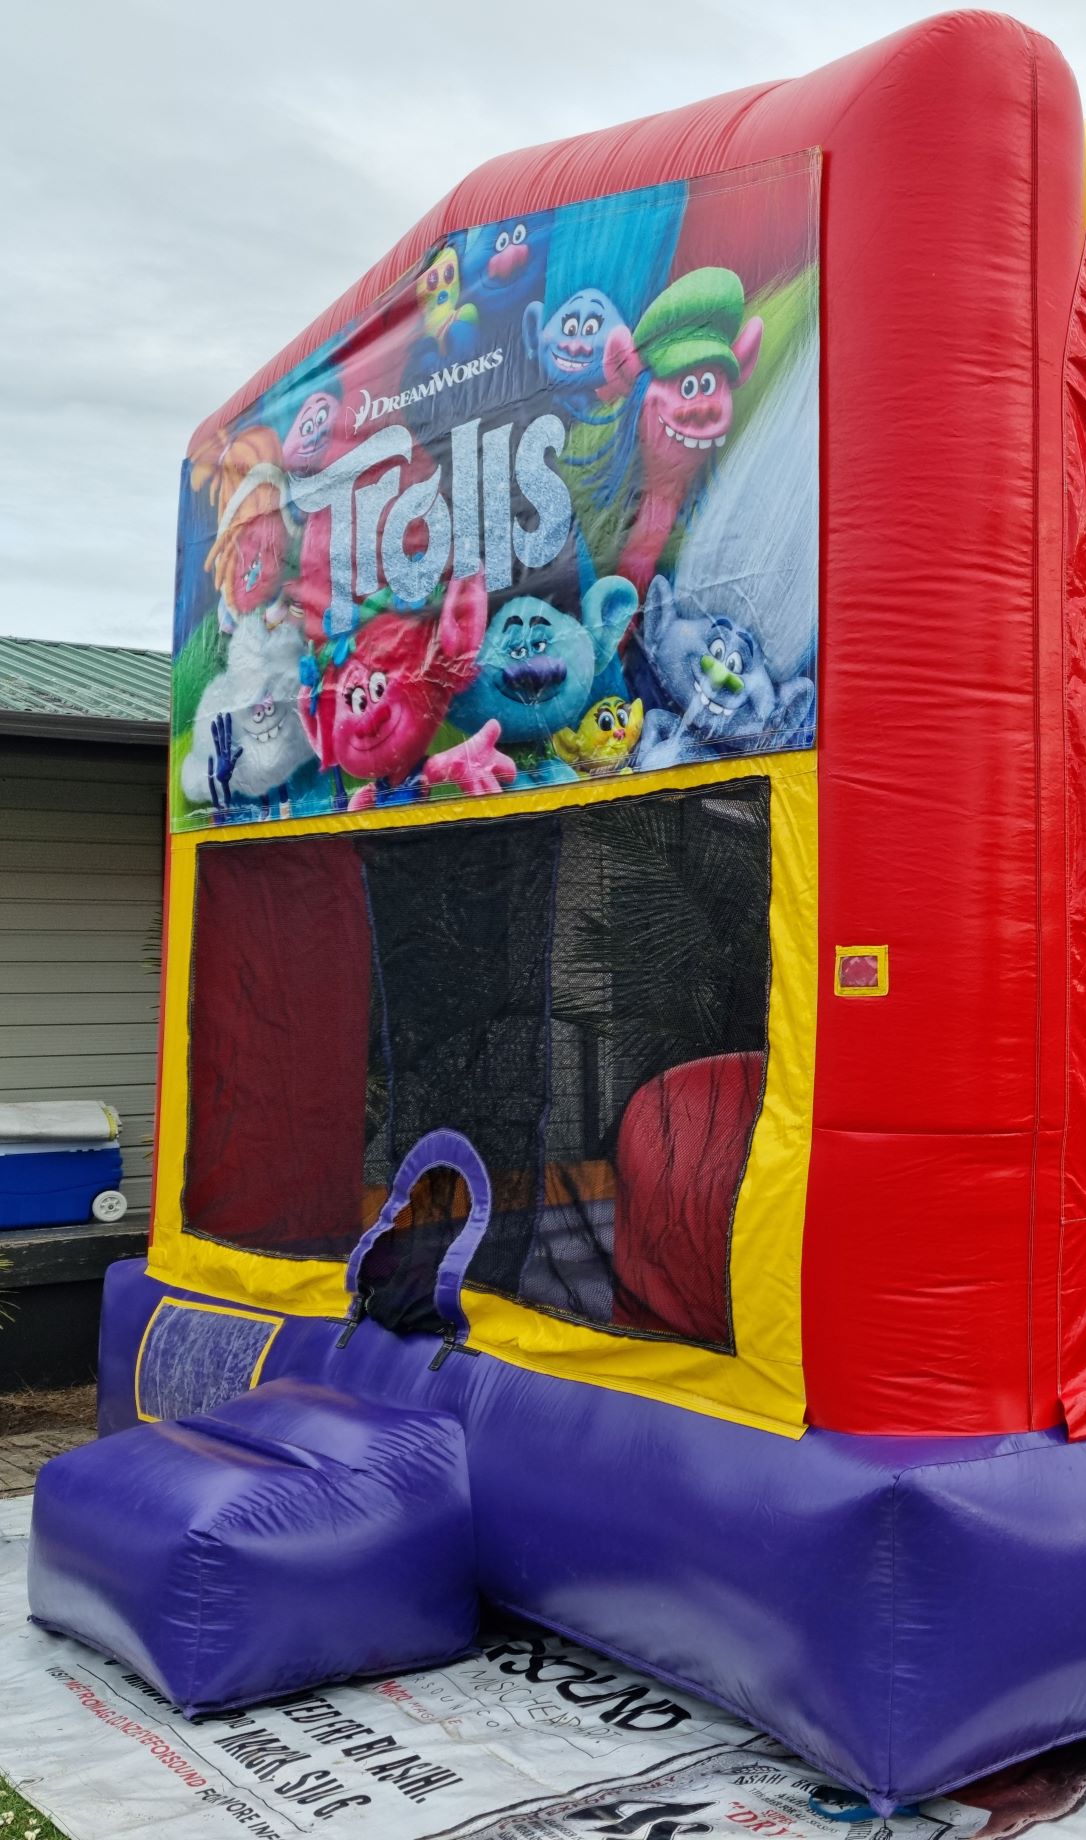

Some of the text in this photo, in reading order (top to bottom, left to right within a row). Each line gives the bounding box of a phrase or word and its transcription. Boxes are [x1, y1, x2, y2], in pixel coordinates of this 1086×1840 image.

[45, 1666, 76, 1686] VISIT
[247, 1821, 281, 1840] INF
[729, 1773, 788, 1786] ASAHI
